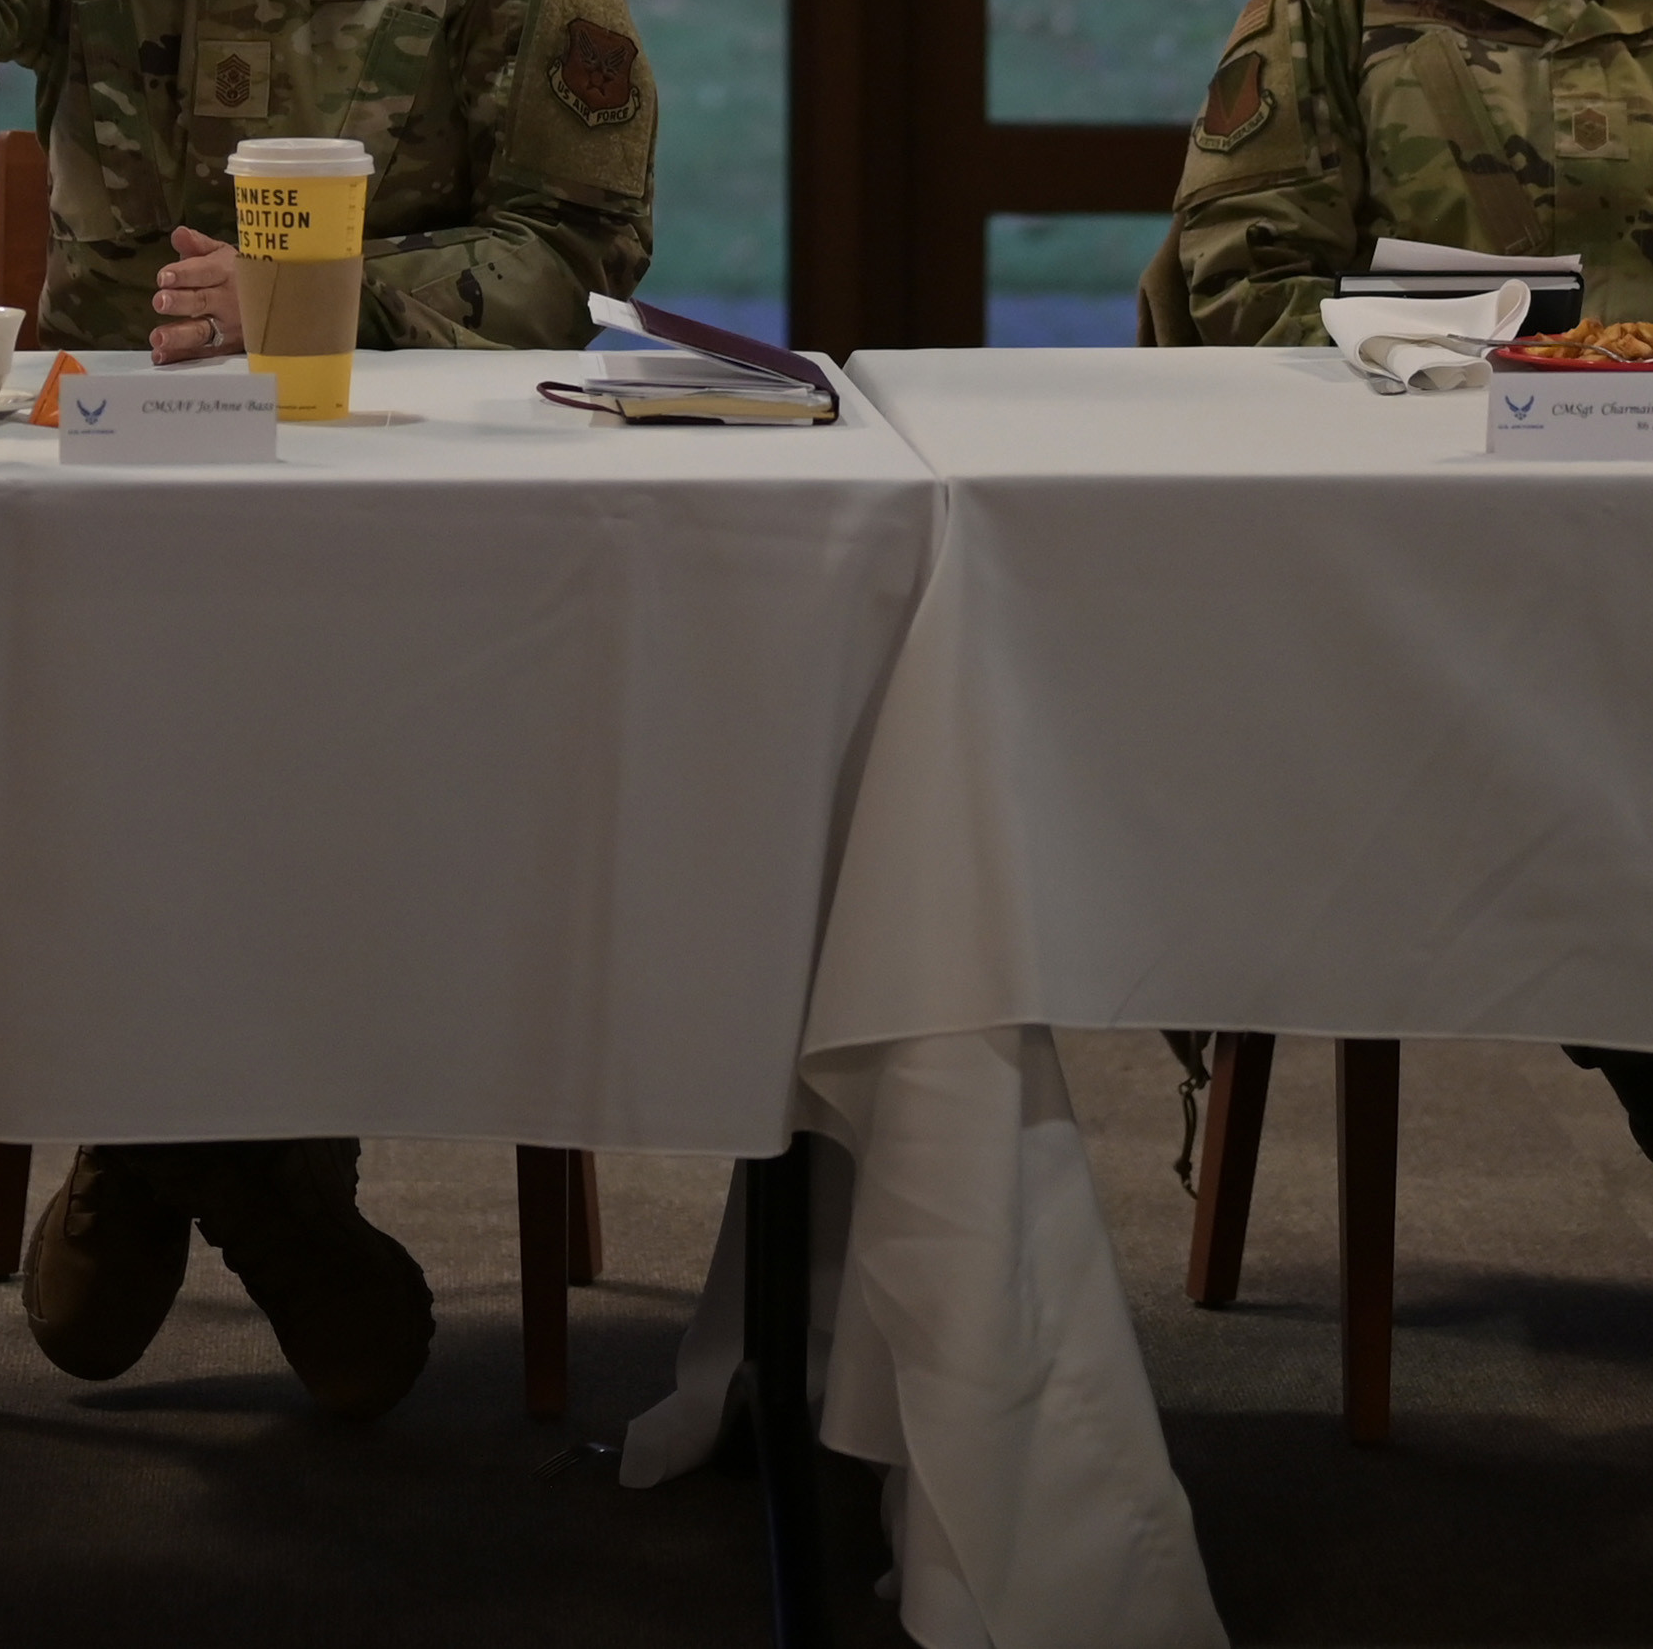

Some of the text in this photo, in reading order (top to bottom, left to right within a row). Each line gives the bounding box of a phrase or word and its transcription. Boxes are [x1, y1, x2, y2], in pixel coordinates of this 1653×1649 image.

[557, 81, 629, 123] US AIR FORCE
[254, 232, 289, 250] THE
[246, 400, 275, 412] Bass
[1551, 403, 1594, 418] CMSgt
